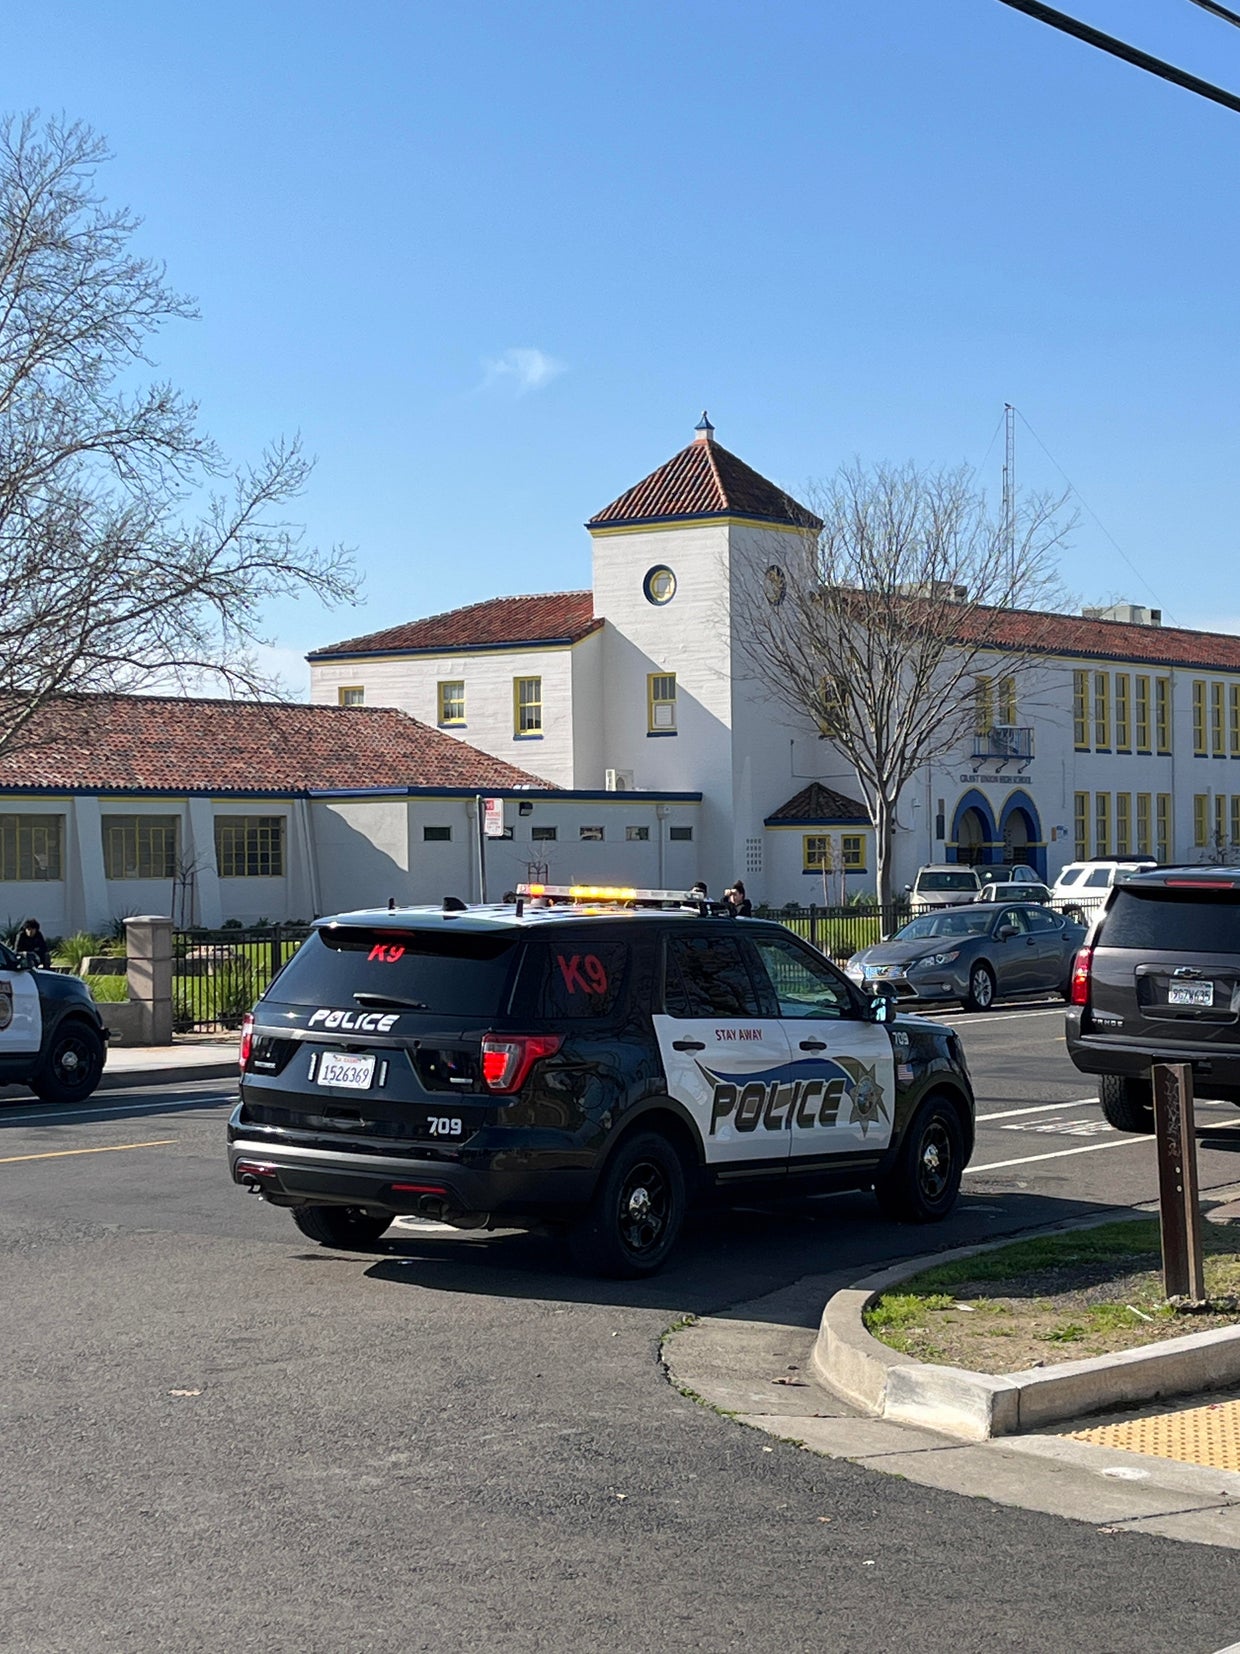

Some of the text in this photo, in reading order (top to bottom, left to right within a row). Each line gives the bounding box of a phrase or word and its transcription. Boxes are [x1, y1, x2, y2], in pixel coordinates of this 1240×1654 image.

[557, 954, 608, 994] K9
[307, 1009, 400, 1032] POLICE
[715, 1029, 762, 1041] STAY AWAY
[892, 1031, 909, 1045] 709
[322, 1064, 370, 1084] 1526369
[709, 1079, 847, 1135] POLICE
[427, 1116, 462, 1135] 709
